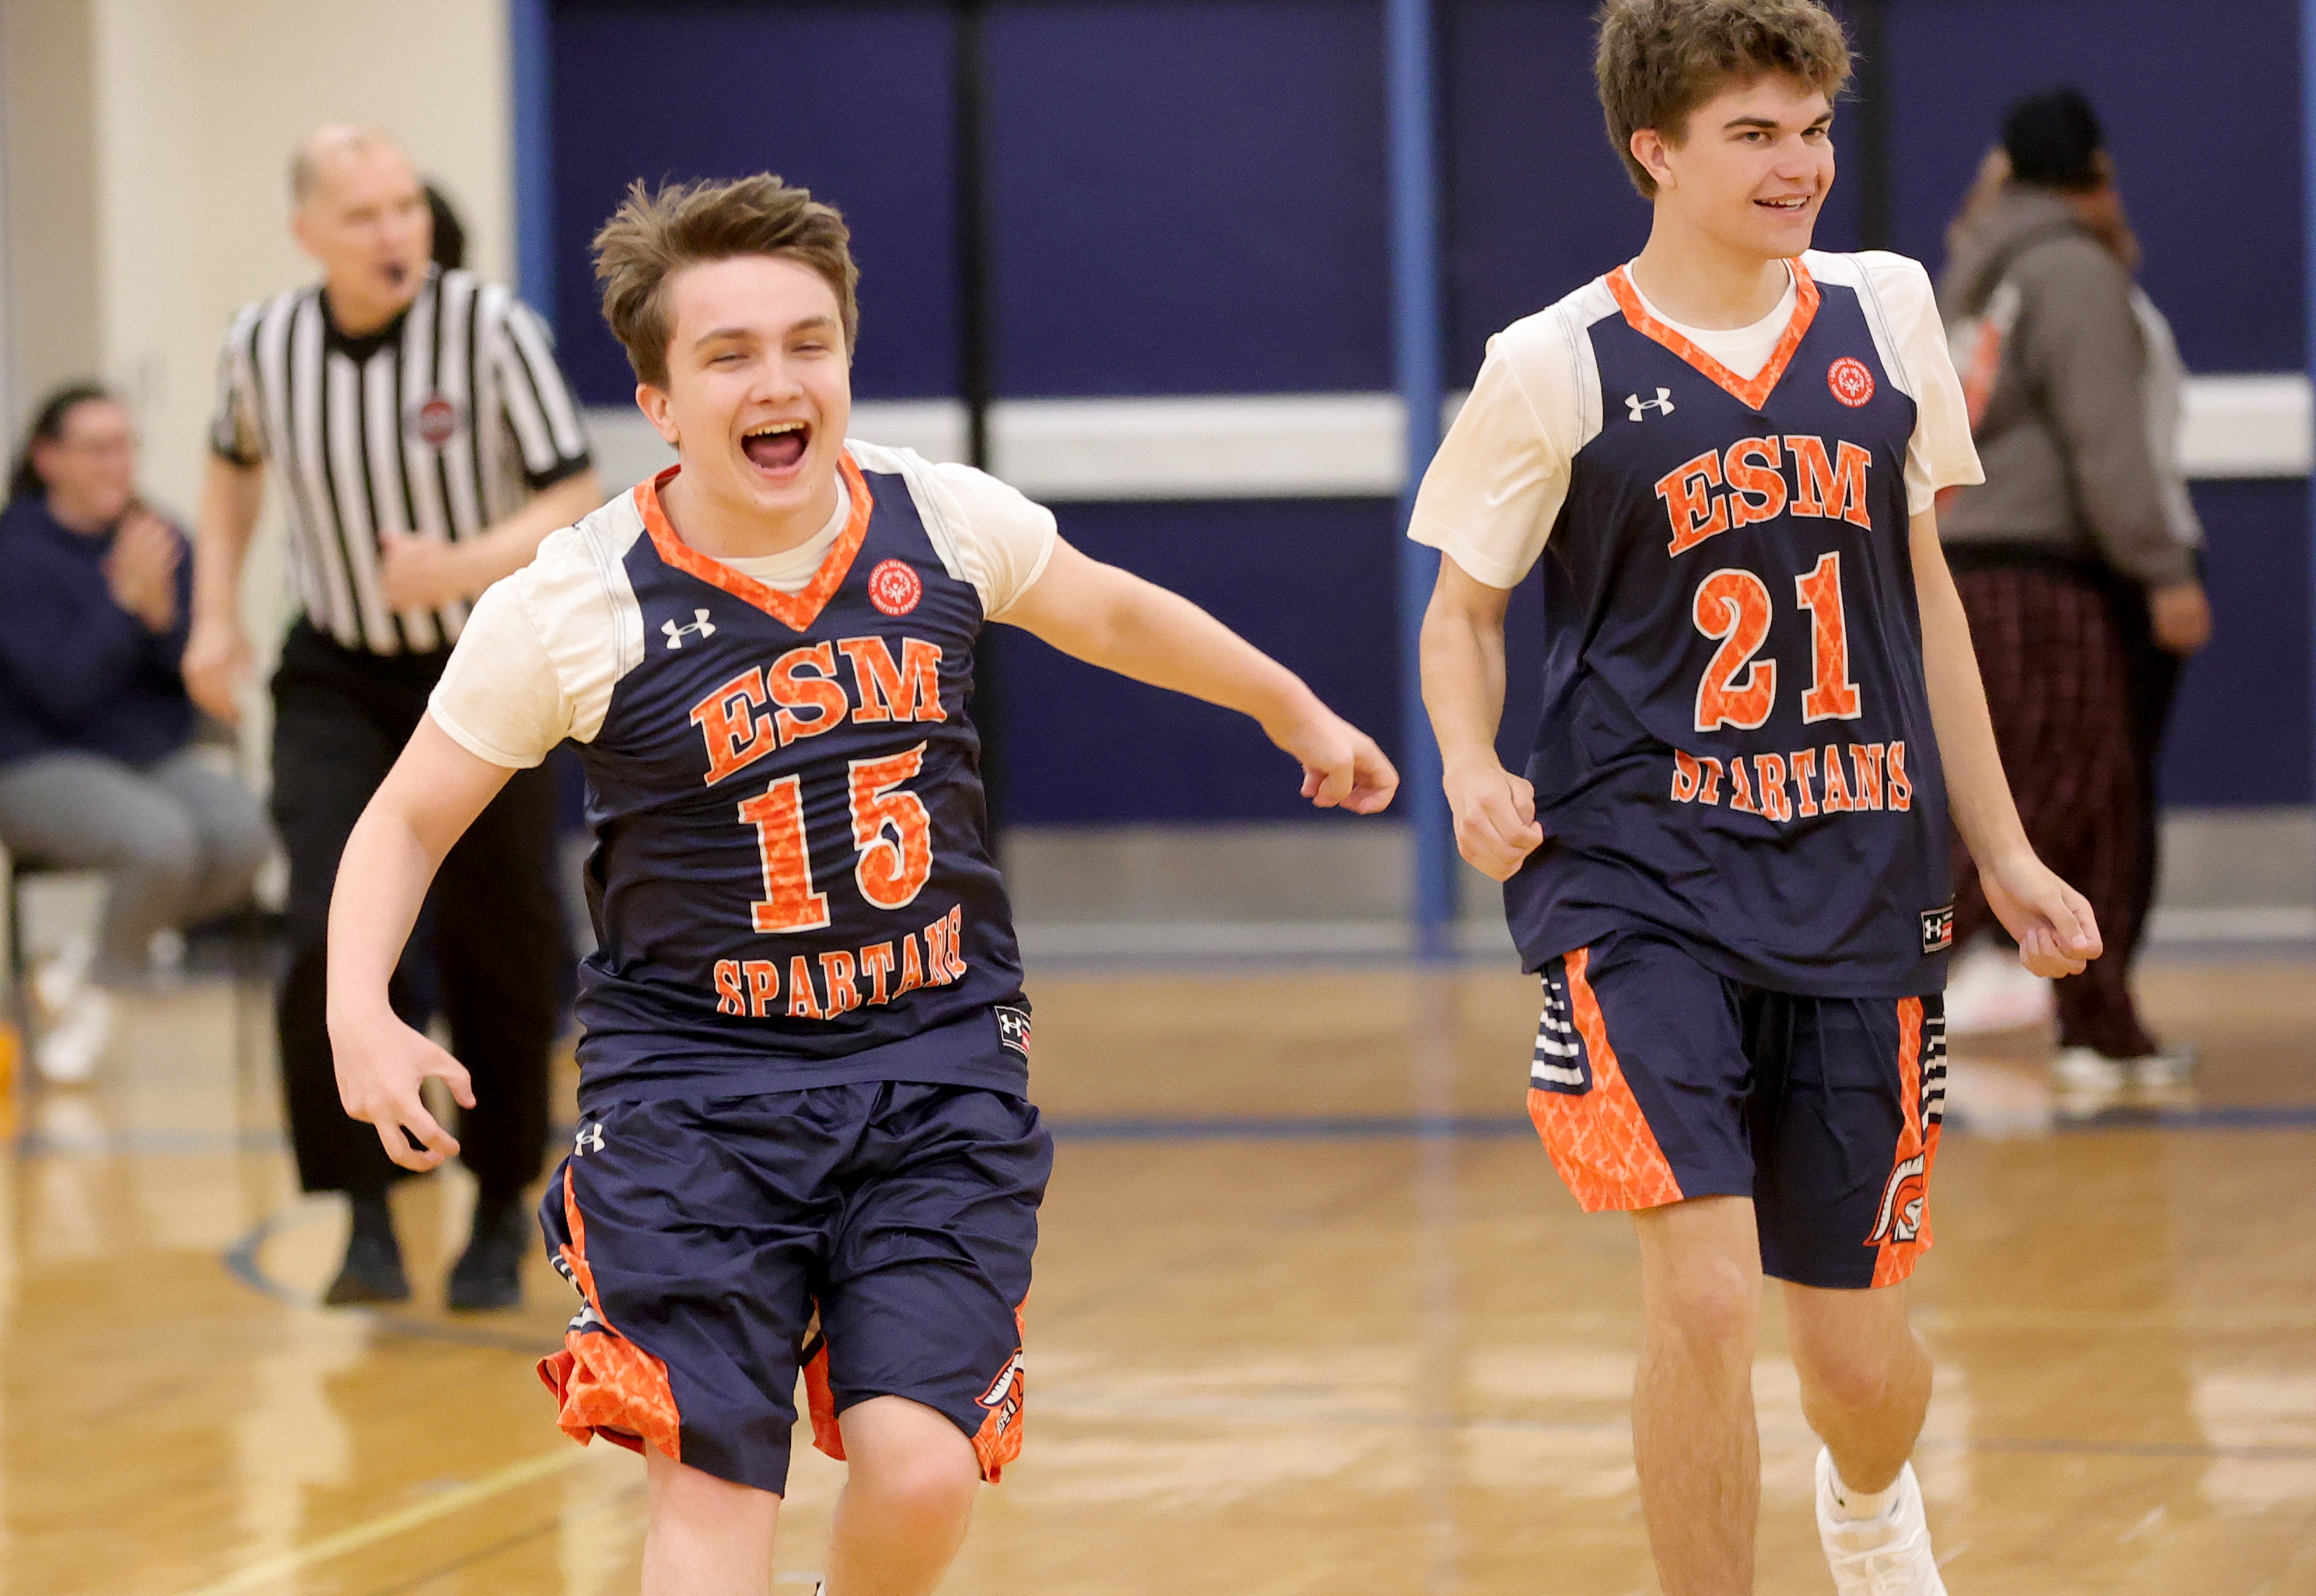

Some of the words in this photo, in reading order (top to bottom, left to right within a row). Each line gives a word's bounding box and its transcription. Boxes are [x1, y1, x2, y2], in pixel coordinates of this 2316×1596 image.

[1654, 434, 1872, 558] ESM
[1692, 551, 1861, 733] 21
[689, 636, 948, 788] ESM
[737, 740, 934, 934] 15
[1670, 740, 1912, 823] SPARTANS
[713, 902, 967, 1021] SPARTANS
